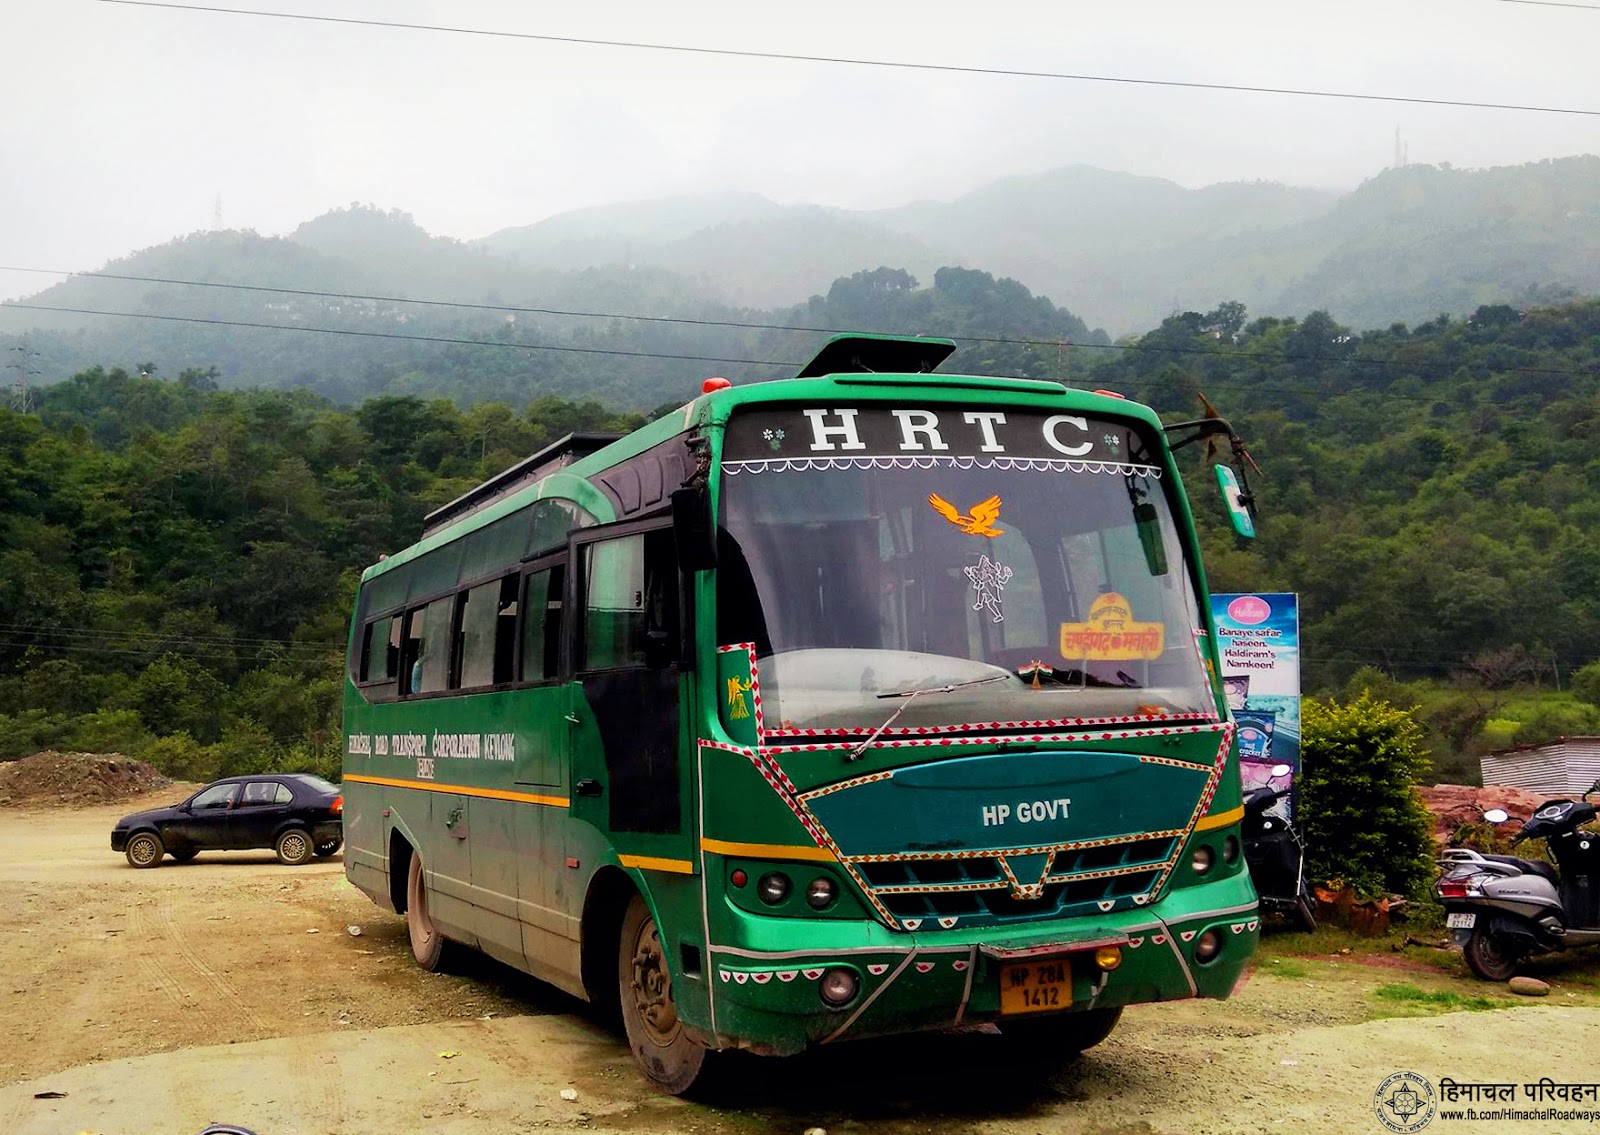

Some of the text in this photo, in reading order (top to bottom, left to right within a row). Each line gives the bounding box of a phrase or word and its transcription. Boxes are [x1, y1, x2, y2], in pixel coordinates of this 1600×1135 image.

[1219, 628, 1253, 638] Banaye
[1225, 649, 1276, 658] Haldiram's
[1227, 659, 1274, 669] Namkeen!
[982, 798, 1071, 827] HP GOVT
[1023, 987, 1059, 1007] 1412
